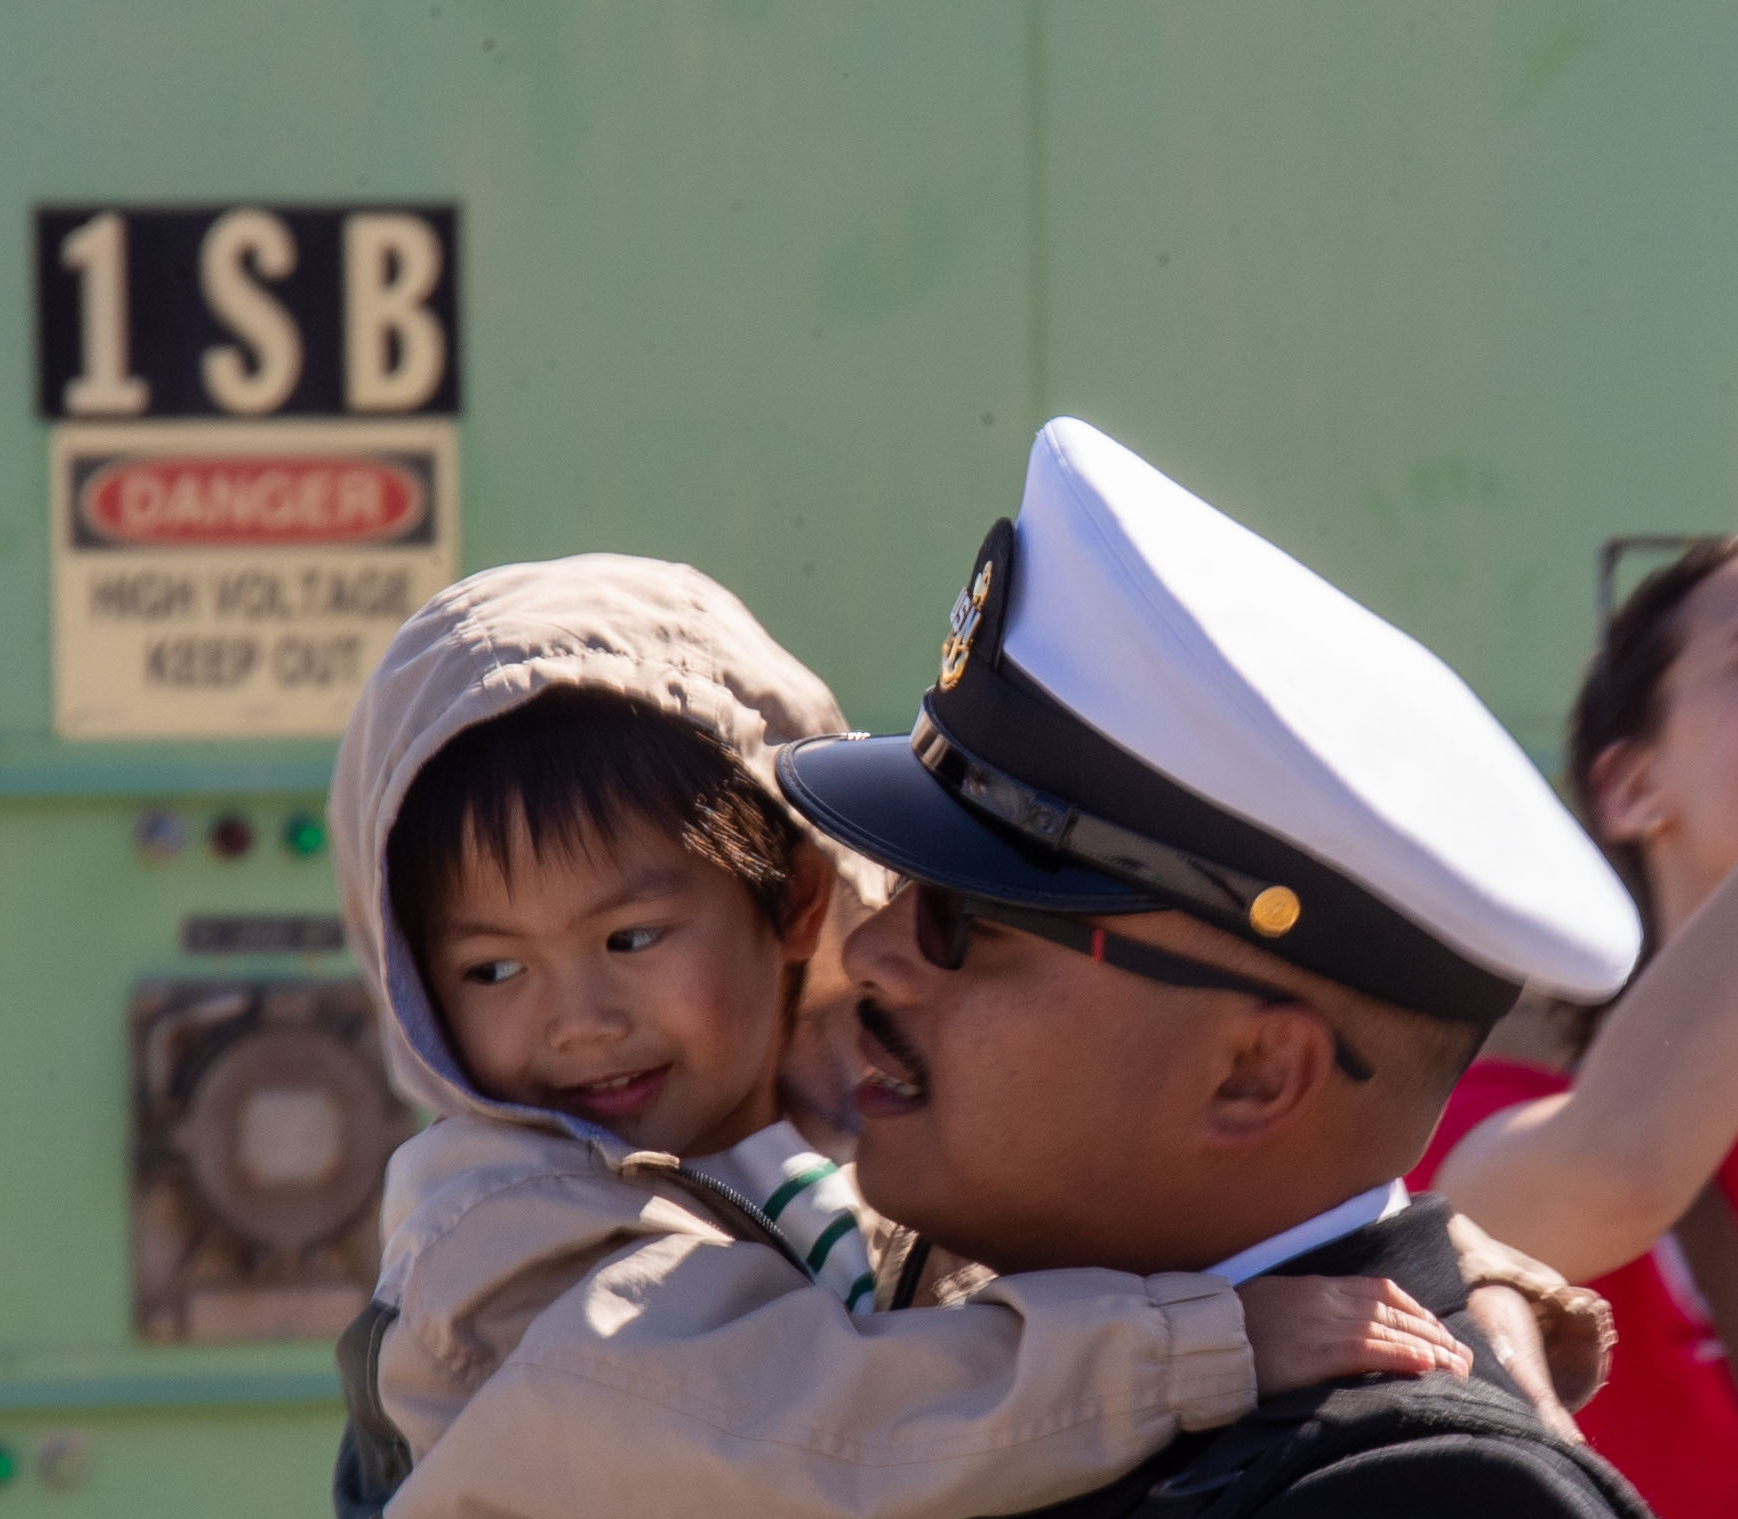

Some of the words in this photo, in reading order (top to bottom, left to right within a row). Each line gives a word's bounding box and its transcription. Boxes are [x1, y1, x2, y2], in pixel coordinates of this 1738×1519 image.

[120, 468, 382, 528] DANGER
[89, 573, 193, 619] HIGH
[213, 568, 412, 620] VOLTAGE
[148, 640, 258, 689] KEEP
[273, 636, 364, 687] OUT
